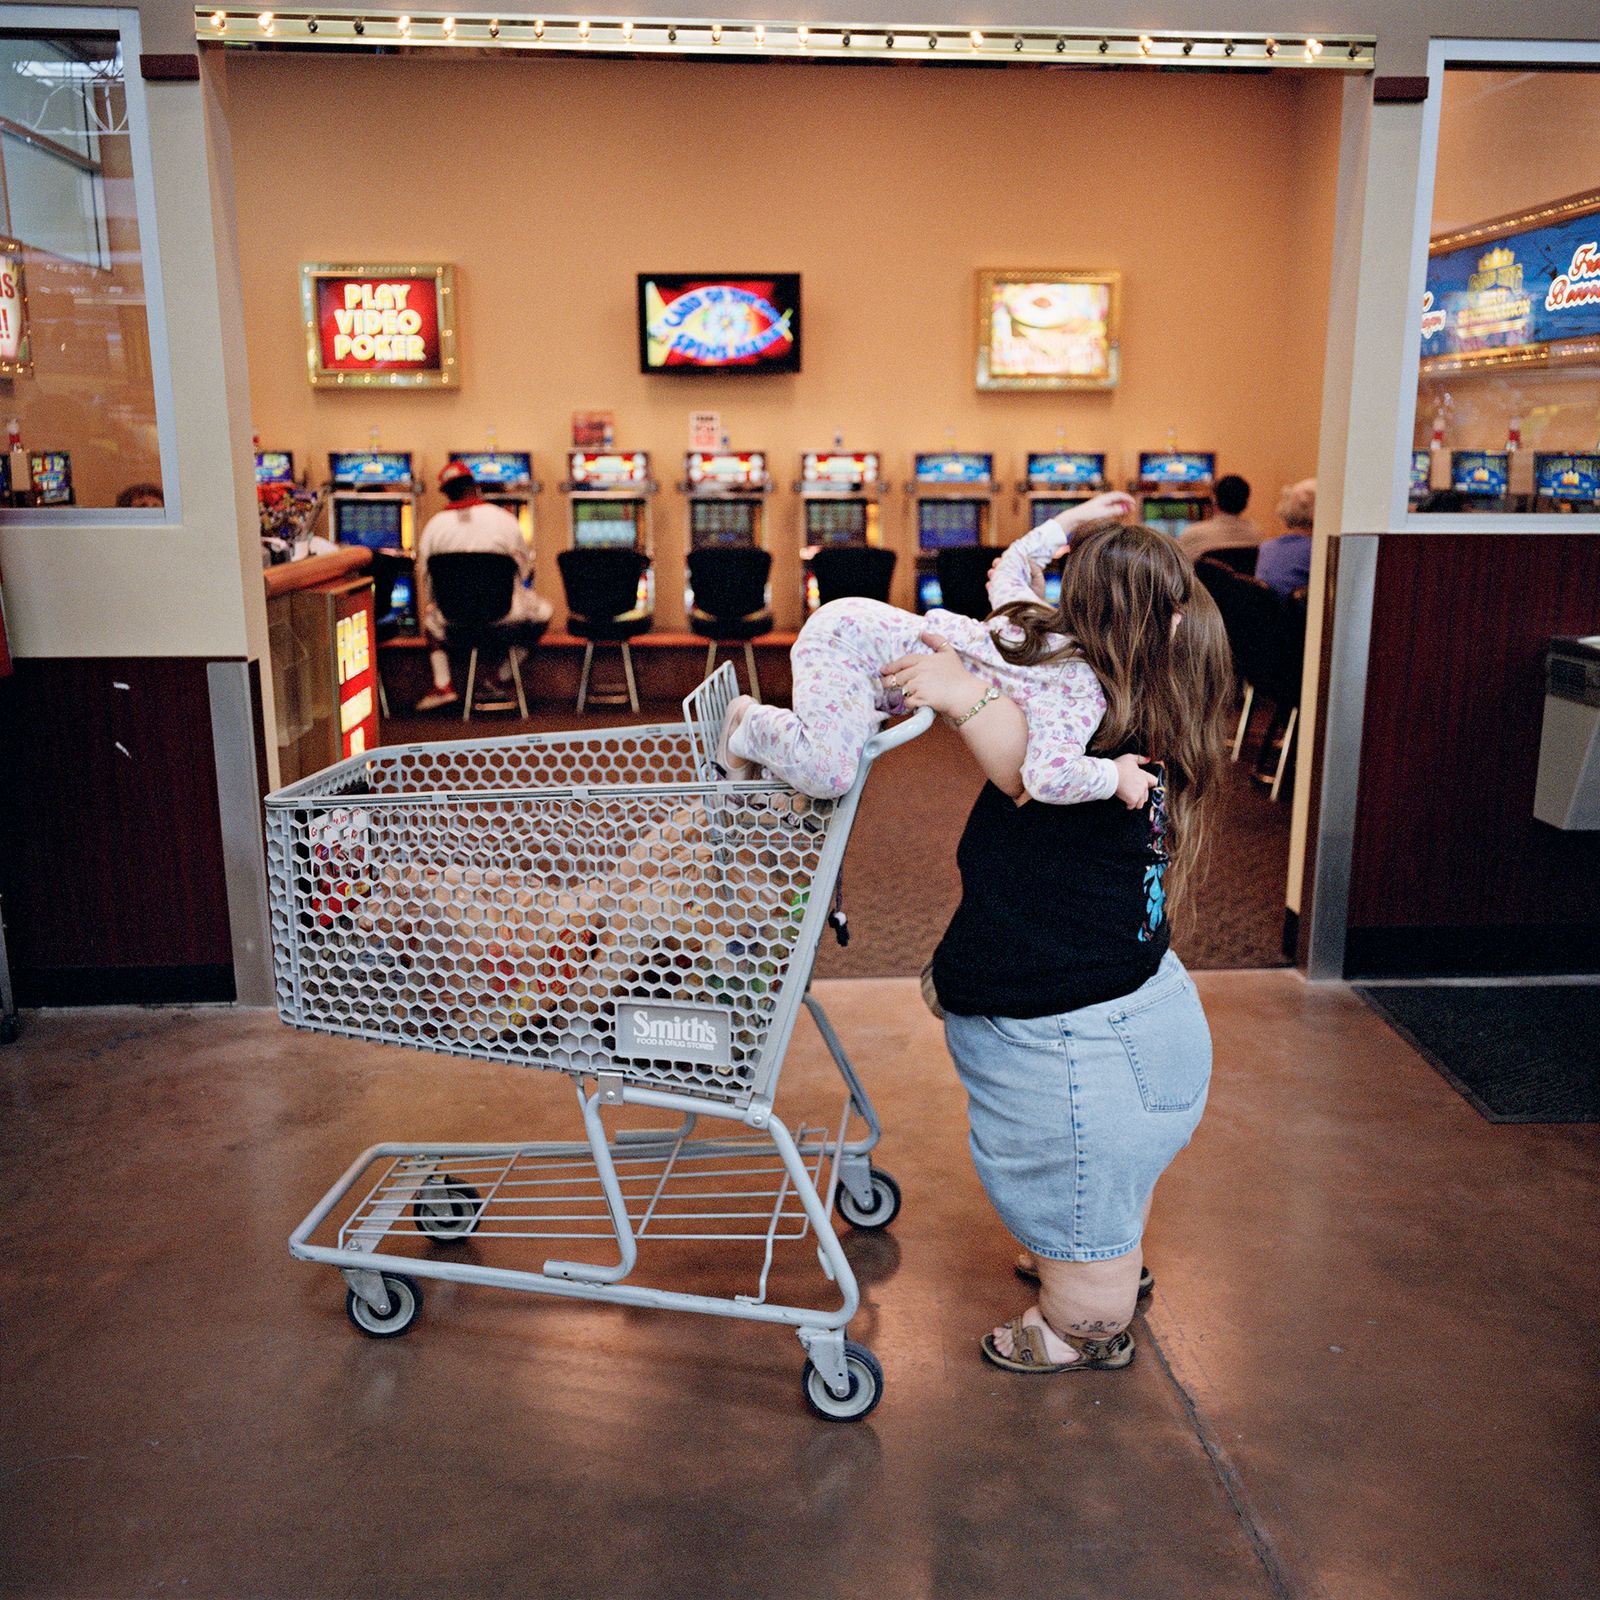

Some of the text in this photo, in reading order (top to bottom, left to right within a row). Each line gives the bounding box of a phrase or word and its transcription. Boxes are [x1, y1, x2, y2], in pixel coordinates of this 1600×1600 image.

[343, 284, 411, 310] PLAY
[334, 309, 422, 336] VIDEO
[334, 334, 427, 362] POKER
[633, 1010, 718, 1045] Smith's
[636, 1038, 716, 1052] FOOD & DRUG STORES
